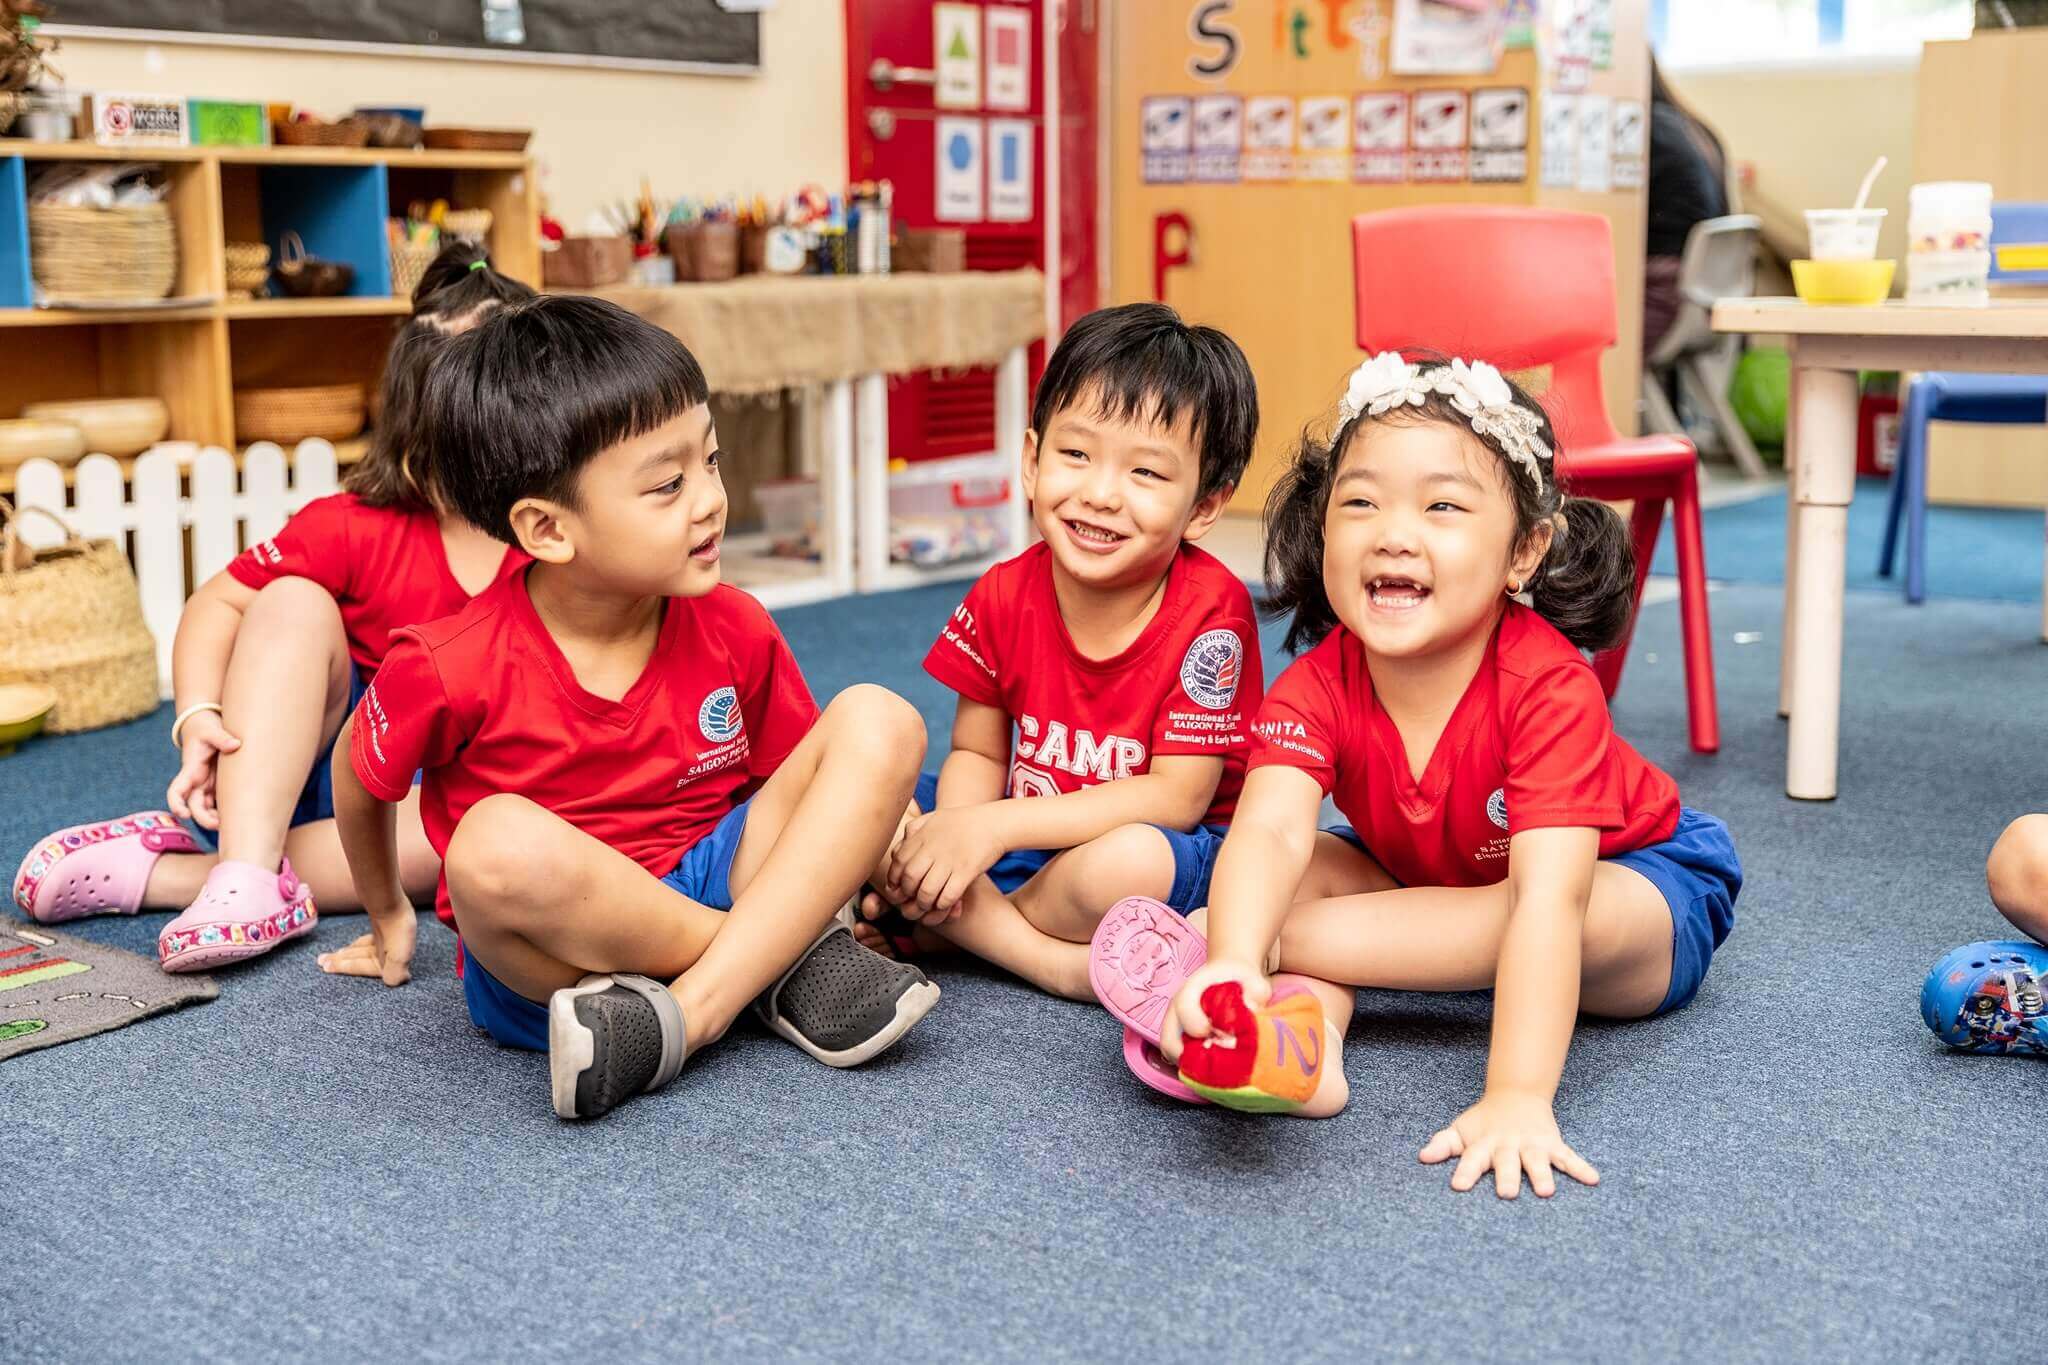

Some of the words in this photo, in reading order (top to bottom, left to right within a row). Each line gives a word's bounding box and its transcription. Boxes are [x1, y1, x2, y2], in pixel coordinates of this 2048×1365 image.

[1169, 710, 1225, 722] International
[1173, 720, 1213, 731] SAIGON
[1017, 713, 1145, 780] CAMP
[1165, 731, 1206, 745] Elementary
[1282, 739, 1326, 764] education
[687, 753, 728, 776] SAIGON
